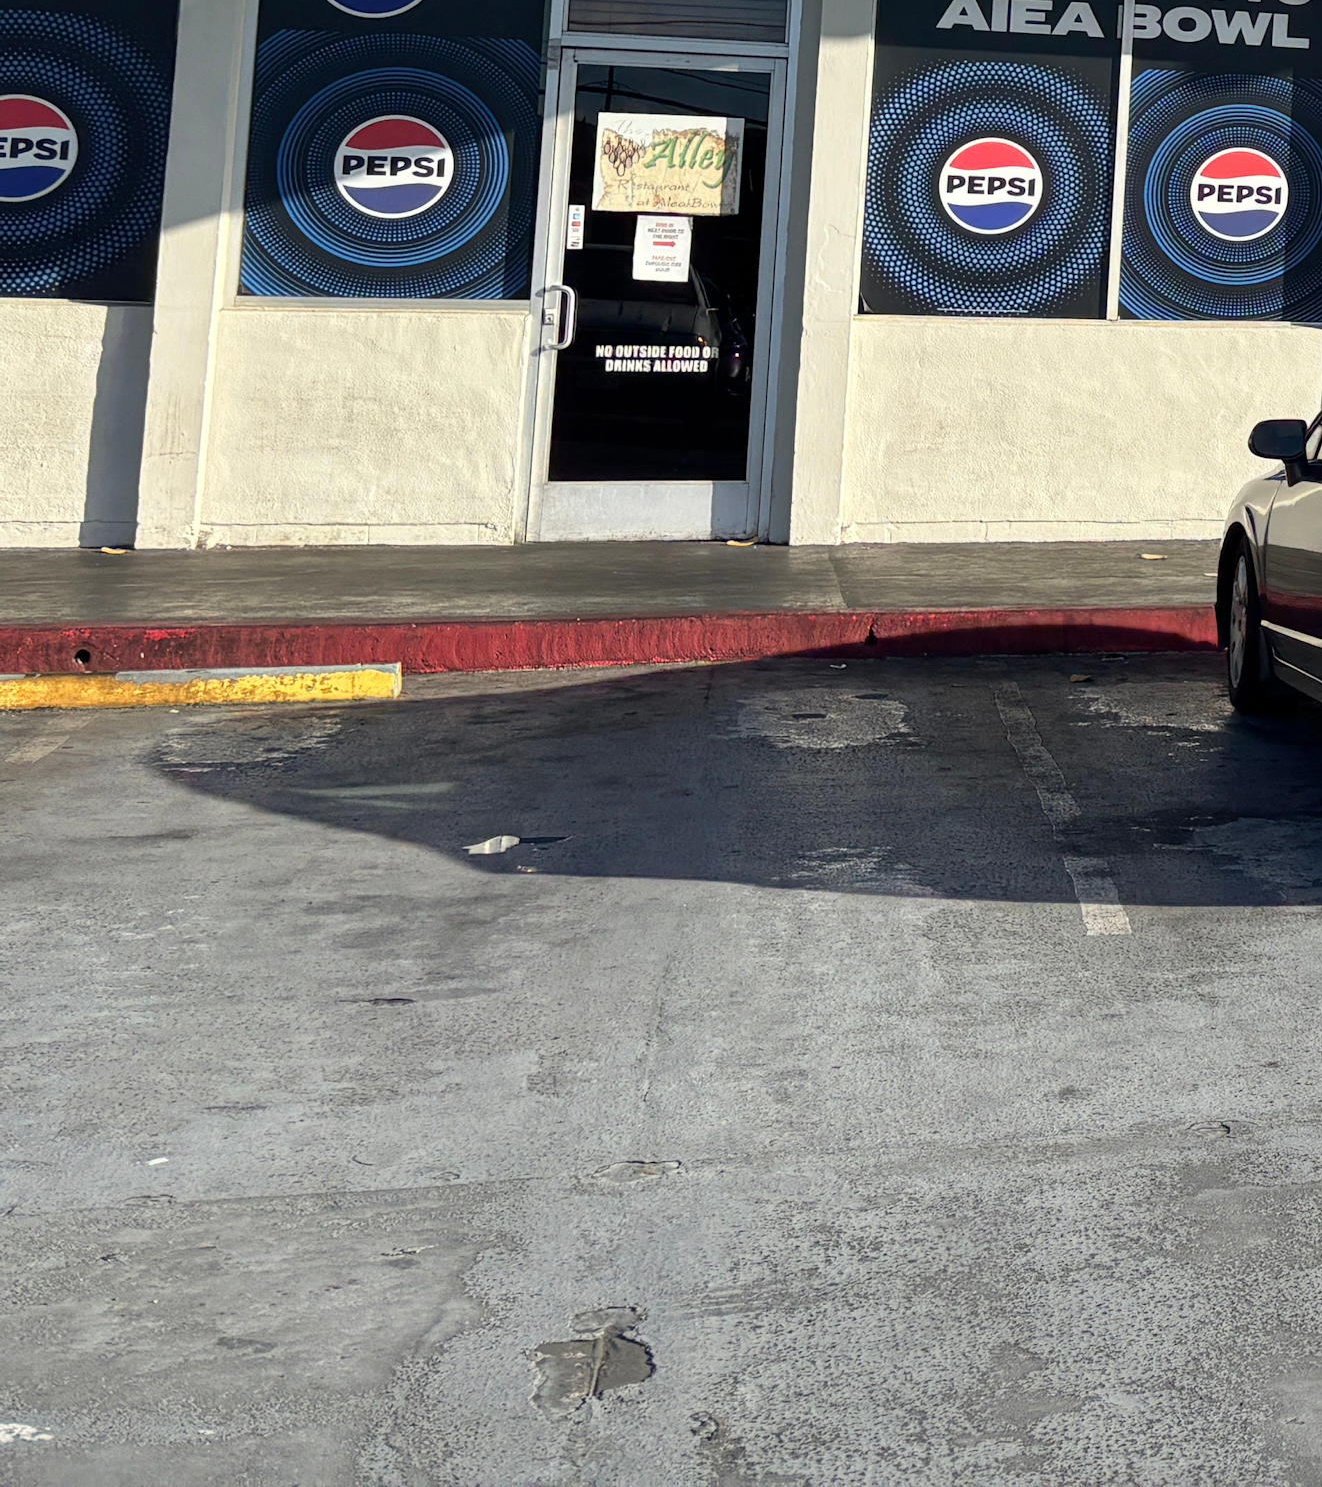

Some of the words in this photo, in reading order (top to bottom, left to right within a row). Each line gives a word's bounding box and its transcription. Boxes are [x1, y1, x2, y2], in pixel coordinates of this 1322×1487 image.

[1116, 4, 1310, 50] BOWL
[341, 154, 446, 179] PEPSI
[644, 132, 735, 189] Alley
[946, 175, 1036, 197] PEPSI
[1197, 184, 1282, 205] PEPSI
[595, 345, 613, 358] NO
[615, 345, 667, 358] OUTSIDE
[669, 346, 699, 359] FOOD
[702, 346, 720, 359] OR
[605, 360, 651, 372] DRINKS
[652, 360, 709, 373] ALLOWED
